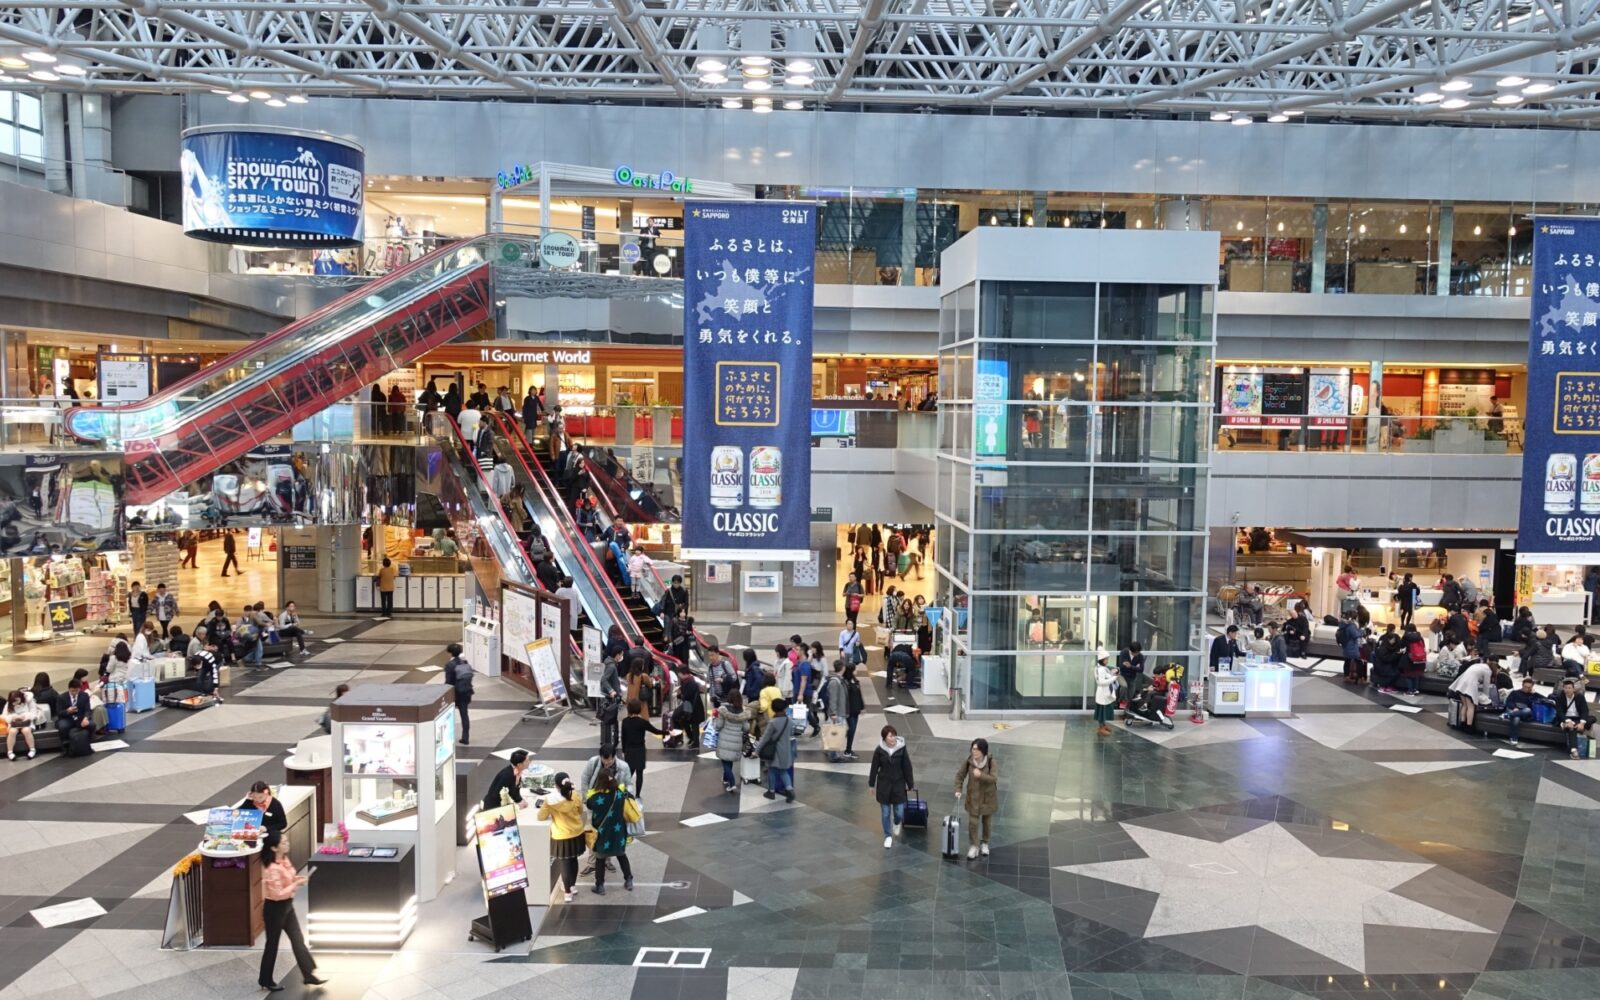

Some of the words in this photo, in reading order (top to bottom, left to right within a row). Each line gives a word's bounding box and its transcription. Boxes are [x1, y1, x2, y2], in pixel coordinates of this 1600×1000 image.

[228, 176, 261, 190] SKY
[270, 177, 319, 195] TOWN
[782, 209, 809, 222] ONLY
[782, 216, 804, 224] 北海道
[709, 238, 793, 254] ふるさとは、
[1554, 253, 1600, 267] ふるさ
[696, 268, 805, 285] いつも僕等に、
[1542, 282, 1600, 298] いつも僕
[723, 298, 772, 314] 笑顔と
[1564, 311, 1598, 327] 笑顔
[699, 328, 802, 345] 勇気をくれる。
[1541, 340, 1597, 356] 勇気をく
[491, 349, 549, 363] Gourmet
[552, 350, 591, 364] World
[725, 371, 771, 383] ふるさと
[1564, 381, 1600, 393] ふるさ
[725, 395, 771, 405] 何ができる
[1264, 401, 1286, 409] World
[725, 406, 771, 419] だろう？
[1563, 404, 1600, 414] 何ができ
[711, 473, 744, 486] CLASSIC
[750, 474, 783, 487] CLASSIC
[1546, 480, 1577, 492] CLASSIC
[713, 512, 779, 533] CLASSIC
[51, 605, 71, 623] 本
